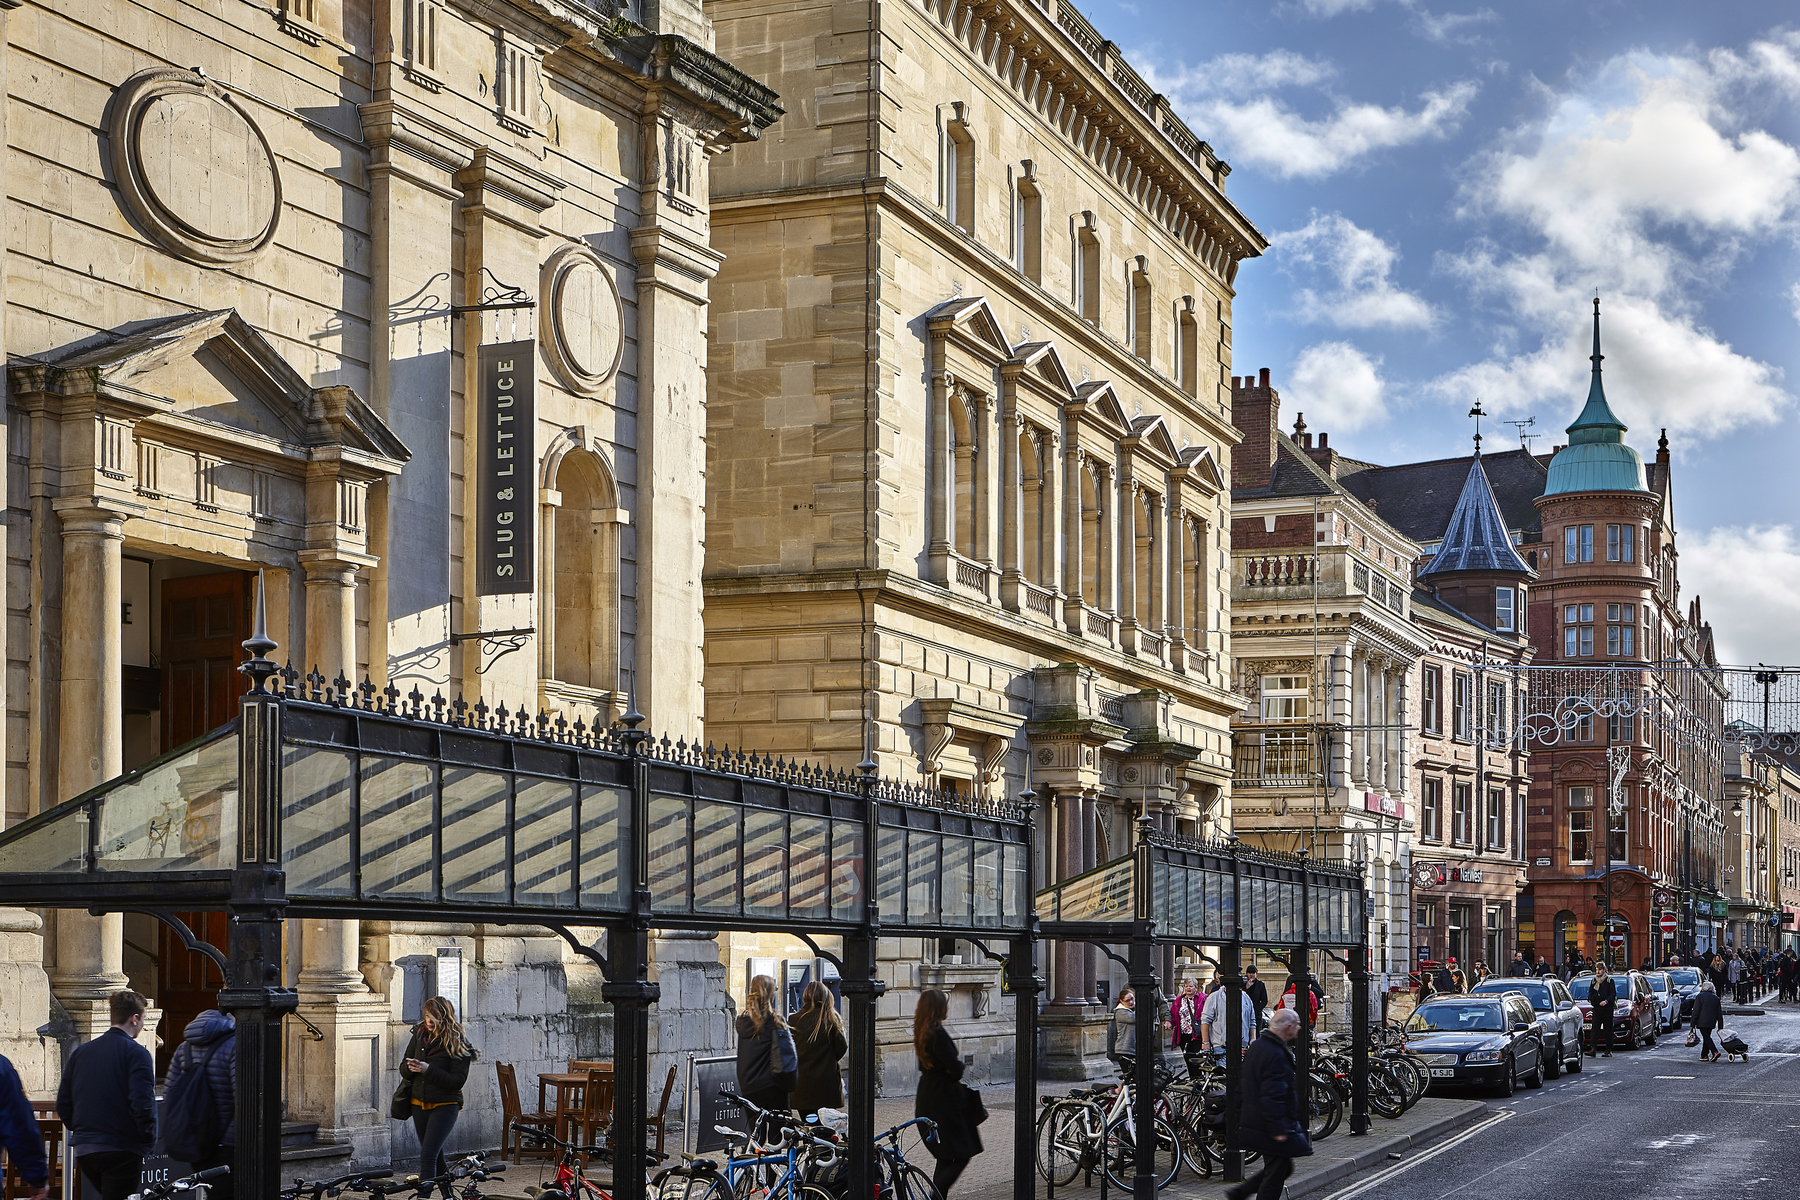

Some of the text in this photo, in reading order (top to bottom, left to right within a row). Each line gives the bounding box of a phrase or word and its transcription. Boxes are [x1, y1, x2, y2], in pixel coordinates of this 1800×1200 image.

[496, 359, 514, 577] SLUG & LETTUCE
[1460, 867, 1483, 883] NatWest
[720, 1081, 735, 1092] SLUG
[715, 1107, 741, 1121] LETTUCE
